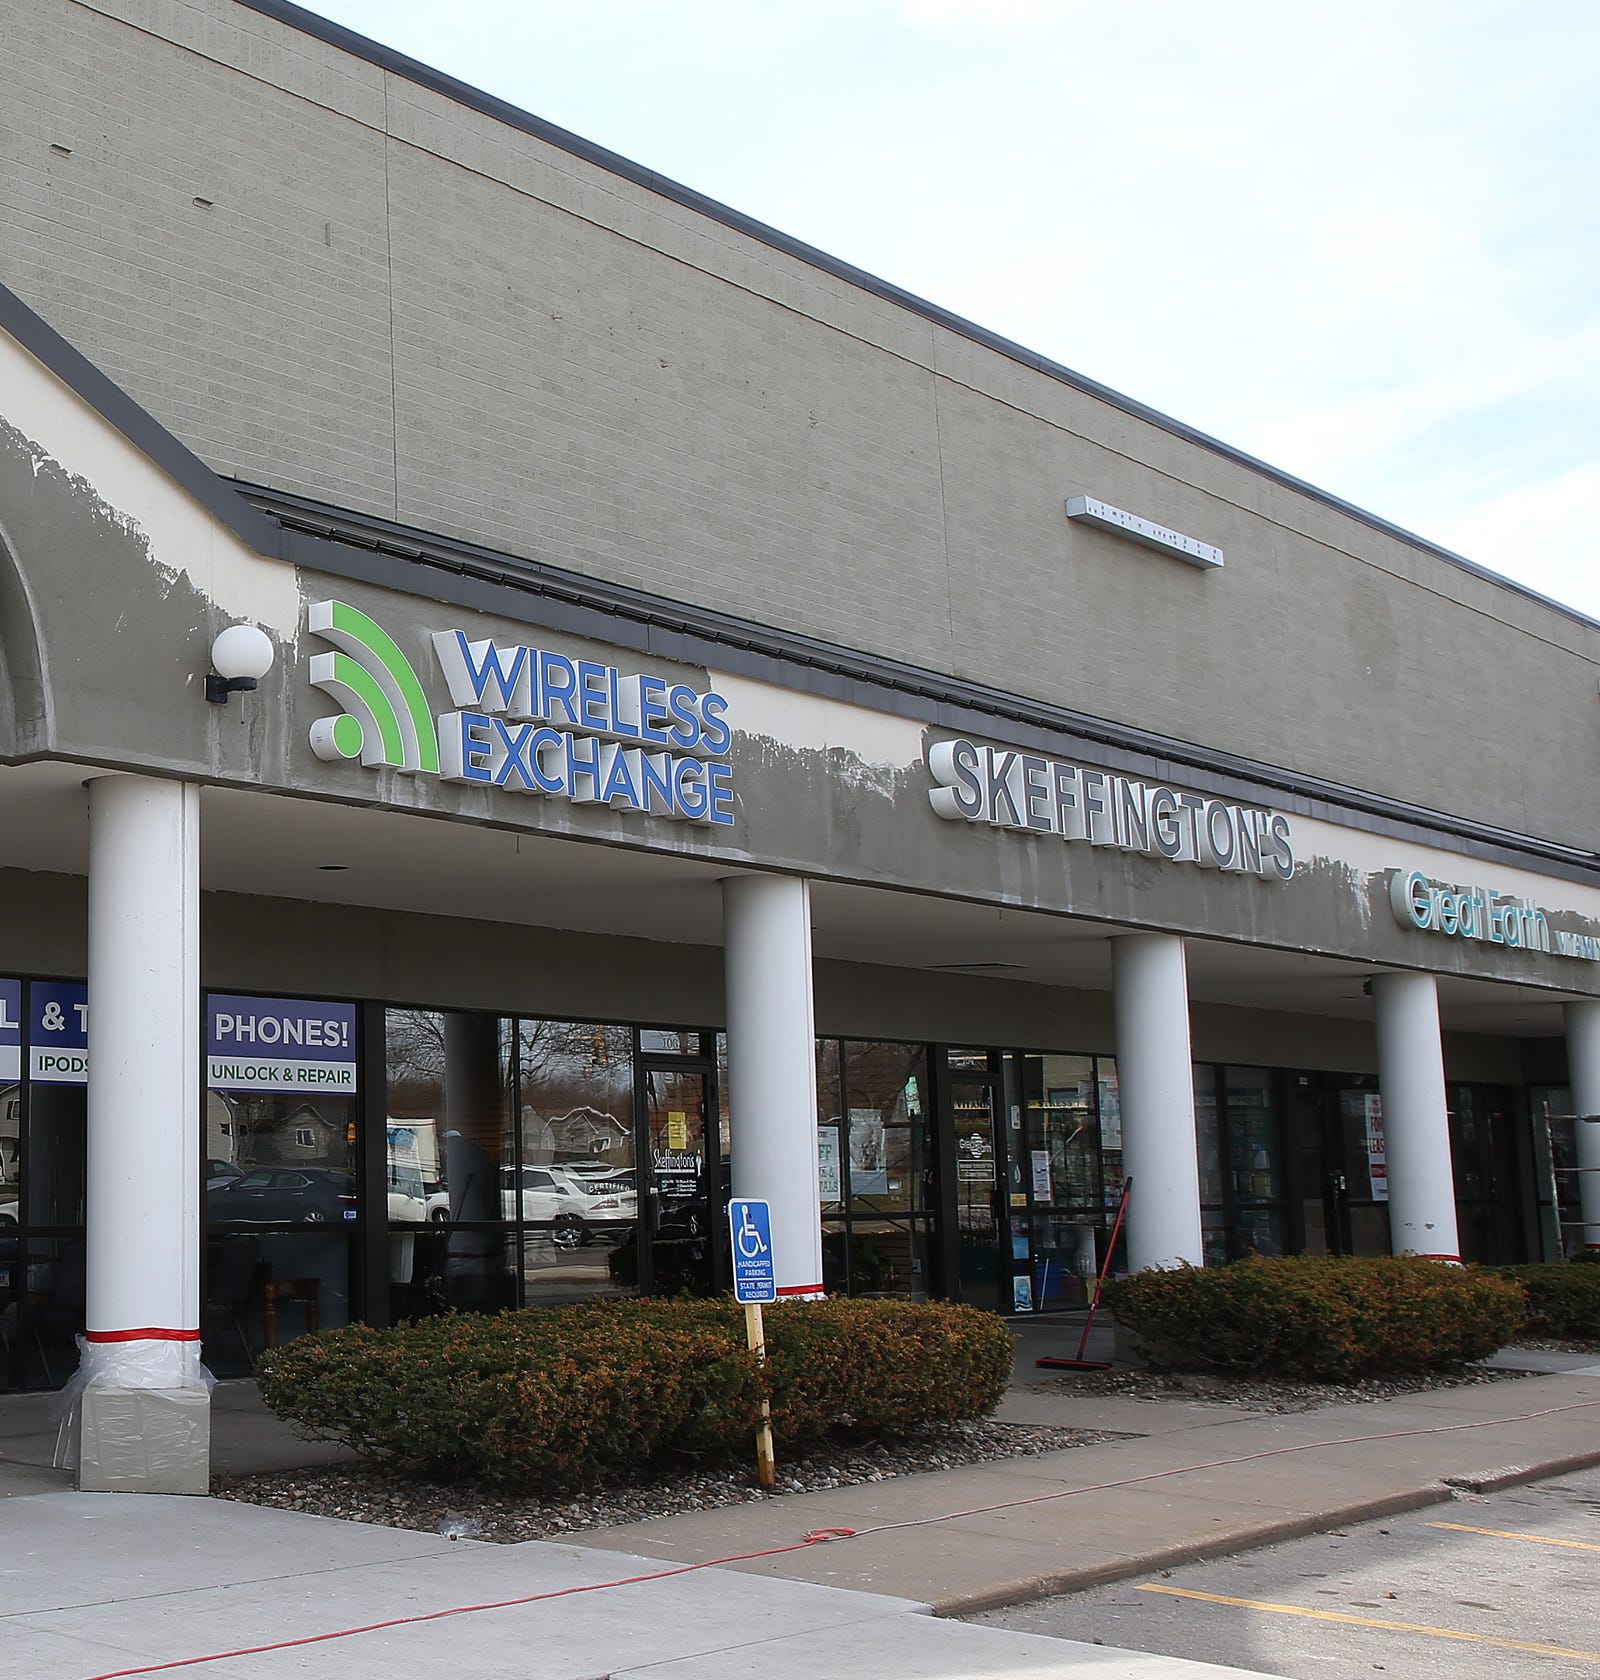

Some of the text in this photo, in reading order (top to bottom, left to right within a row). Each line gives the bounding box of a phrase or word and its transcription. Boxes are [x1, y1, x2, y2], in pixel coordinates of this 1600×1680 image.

[450, 629, 732, 756] WIRELESS
[456, 710, 735, 826] EXCHANGE
[942, 738, 1295, 881] SKEFFINGTON'S
[1404, 870, 1483, 940] Great
[1485, 888, 1550, 953] Earth
[42, 1001, 66, 1032] &
[215, 1013, 349, 1047] PHONES!
[211, 1064, 279, 1082] UNLOCK
[282, 1067, 293, 1082] &
[297, 1068, 352, 1085] REPAIR
[653, 1148, 695, 1169] Skeffington's
[588, 1182, 631, 1193] CERTIFIED
[744, 1269, 767, 1277] PARKING
[740, 1282, 755, 1290] STATE
[745, 1290, 769, 1299] REQUIRED
